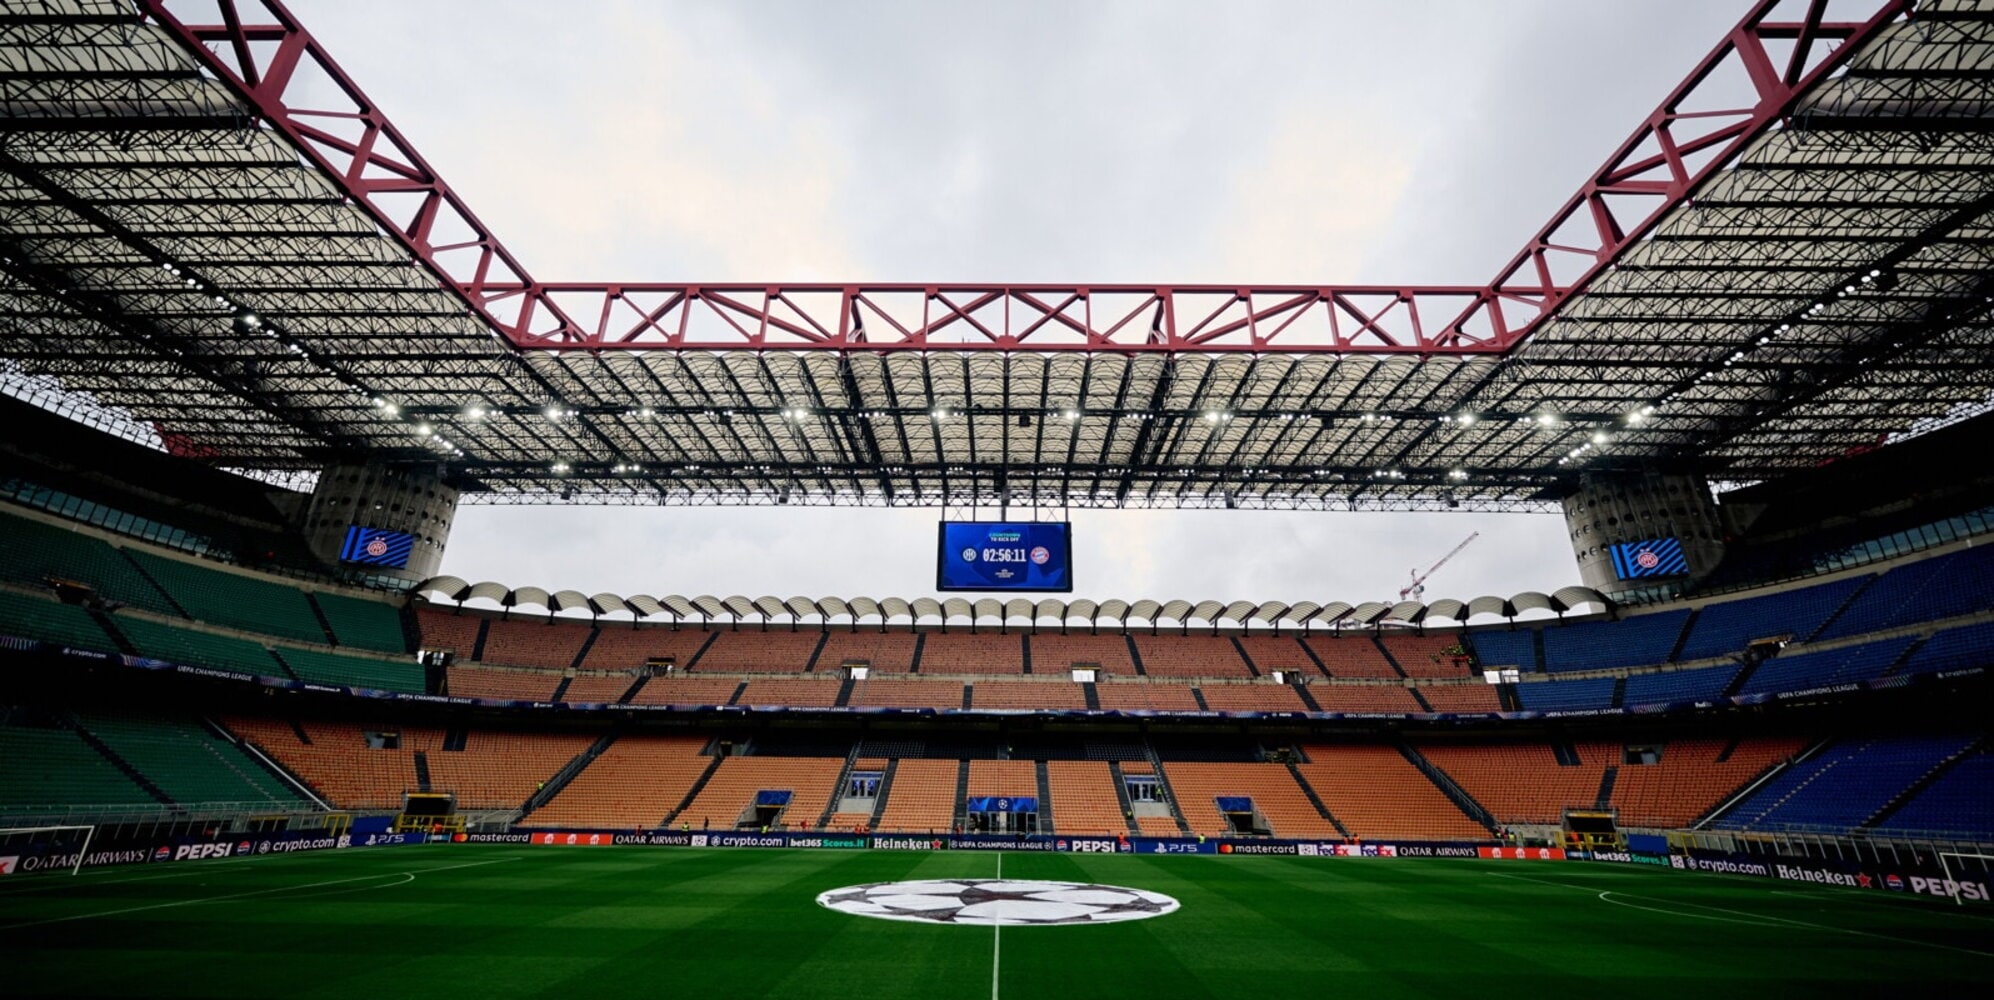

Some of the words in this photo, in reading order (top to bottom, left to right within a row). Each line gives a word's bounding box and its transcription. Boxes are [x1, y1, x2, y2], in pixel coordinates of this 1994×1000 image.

[983, 549, 1026, 562] 02:56:11
[177, 665, 194, 673] UEFA
[195, 668, 230, 679] CHAMPIONS
[231, 673, 253, 681] LEAGUE
[1794, 687, 1831, 697] CHAMPIONS
[1832, 684, 1859, 692] LEAGUE
[378, 834, 405, 843] PS5
[470, 833, 529, 842] mastercard
[616, 835, 646, 844] QATAR
[649, 835, 688, 844] AIRWAYS
[723, 836, 783, 848] crypto.com
[790, 838, 822, 847] bet365
[823, 839, 865, 847] Scores.it
[874, 838, 930, 849] Heineken
[273, 838, 334, 852] crypto.com
[959, 840, 976, 848] UEFA
[977, 840, 1016, 848] CHAMPIONS
[1018, 841, 1043, 849] LEAGUE
[1072, 840, 1115, 852] PEPSI
[1169, 843, 1198, 852] PS5
[1235, 844, 1295, 853] mastercard
[175, 842, 233, 861] PEPSI
[1400, 847, 1432, 856] QATAR
[1436, 847, 1475, 856] AIRWAYS
[1594, 851, 1631, 862] bet365
[23, 854, 80, 871] QATAR
[83, 849, 145, 866] AIRWAYS
[1699, 859, 1767, 875] crypto.com
[1776, 864, 1857, 887] Heineken
[1909, 876, 1990, 900] PEPSI
